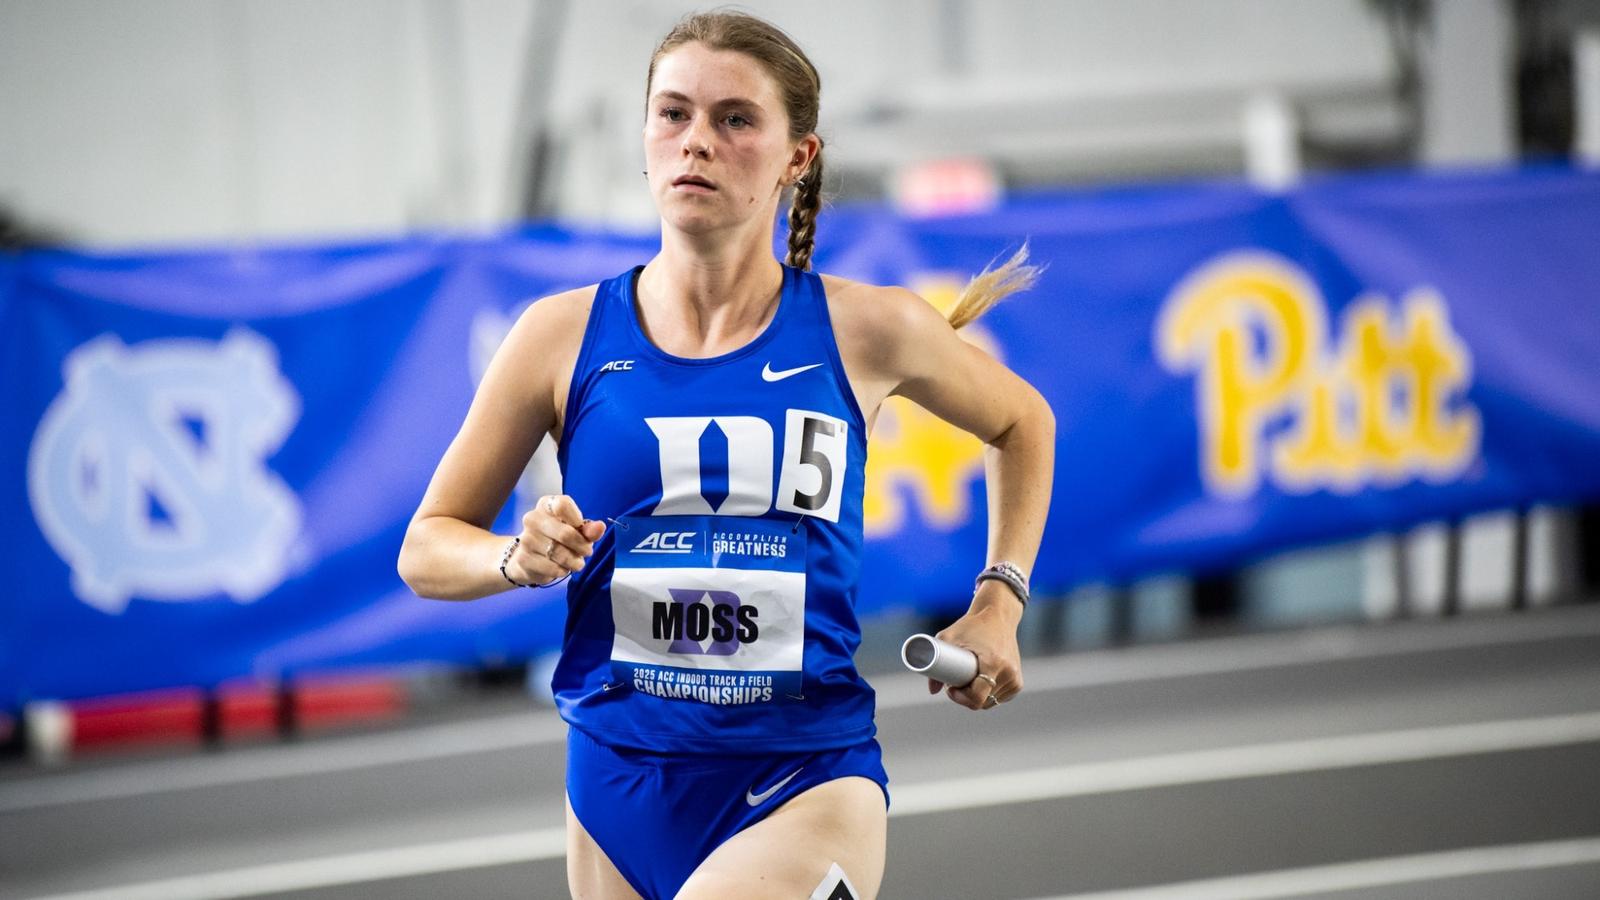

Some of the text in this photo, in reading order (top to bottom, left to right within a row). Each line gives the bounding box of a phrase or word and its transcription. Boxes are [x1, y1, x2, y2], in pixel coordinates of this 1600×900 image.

[600, 360, 635, 372] ACC
[1157, 250, 1483, 496] Pitt
[643, 416, 774, 516] D
[793, 417, 835, 511] 5
[635, 532, 697, 549] ACC
[713, 532, 787, 544] ACCOMPLISH
[713, 541, 786, 558] GREATNESS
[652, 601, 759, 643] MOSS
[633, 668, 772, 687] 2025 ACC INDOOR TRACK & FIELD
[633, 678, 773, 705] CHAMPIONSHIPS
